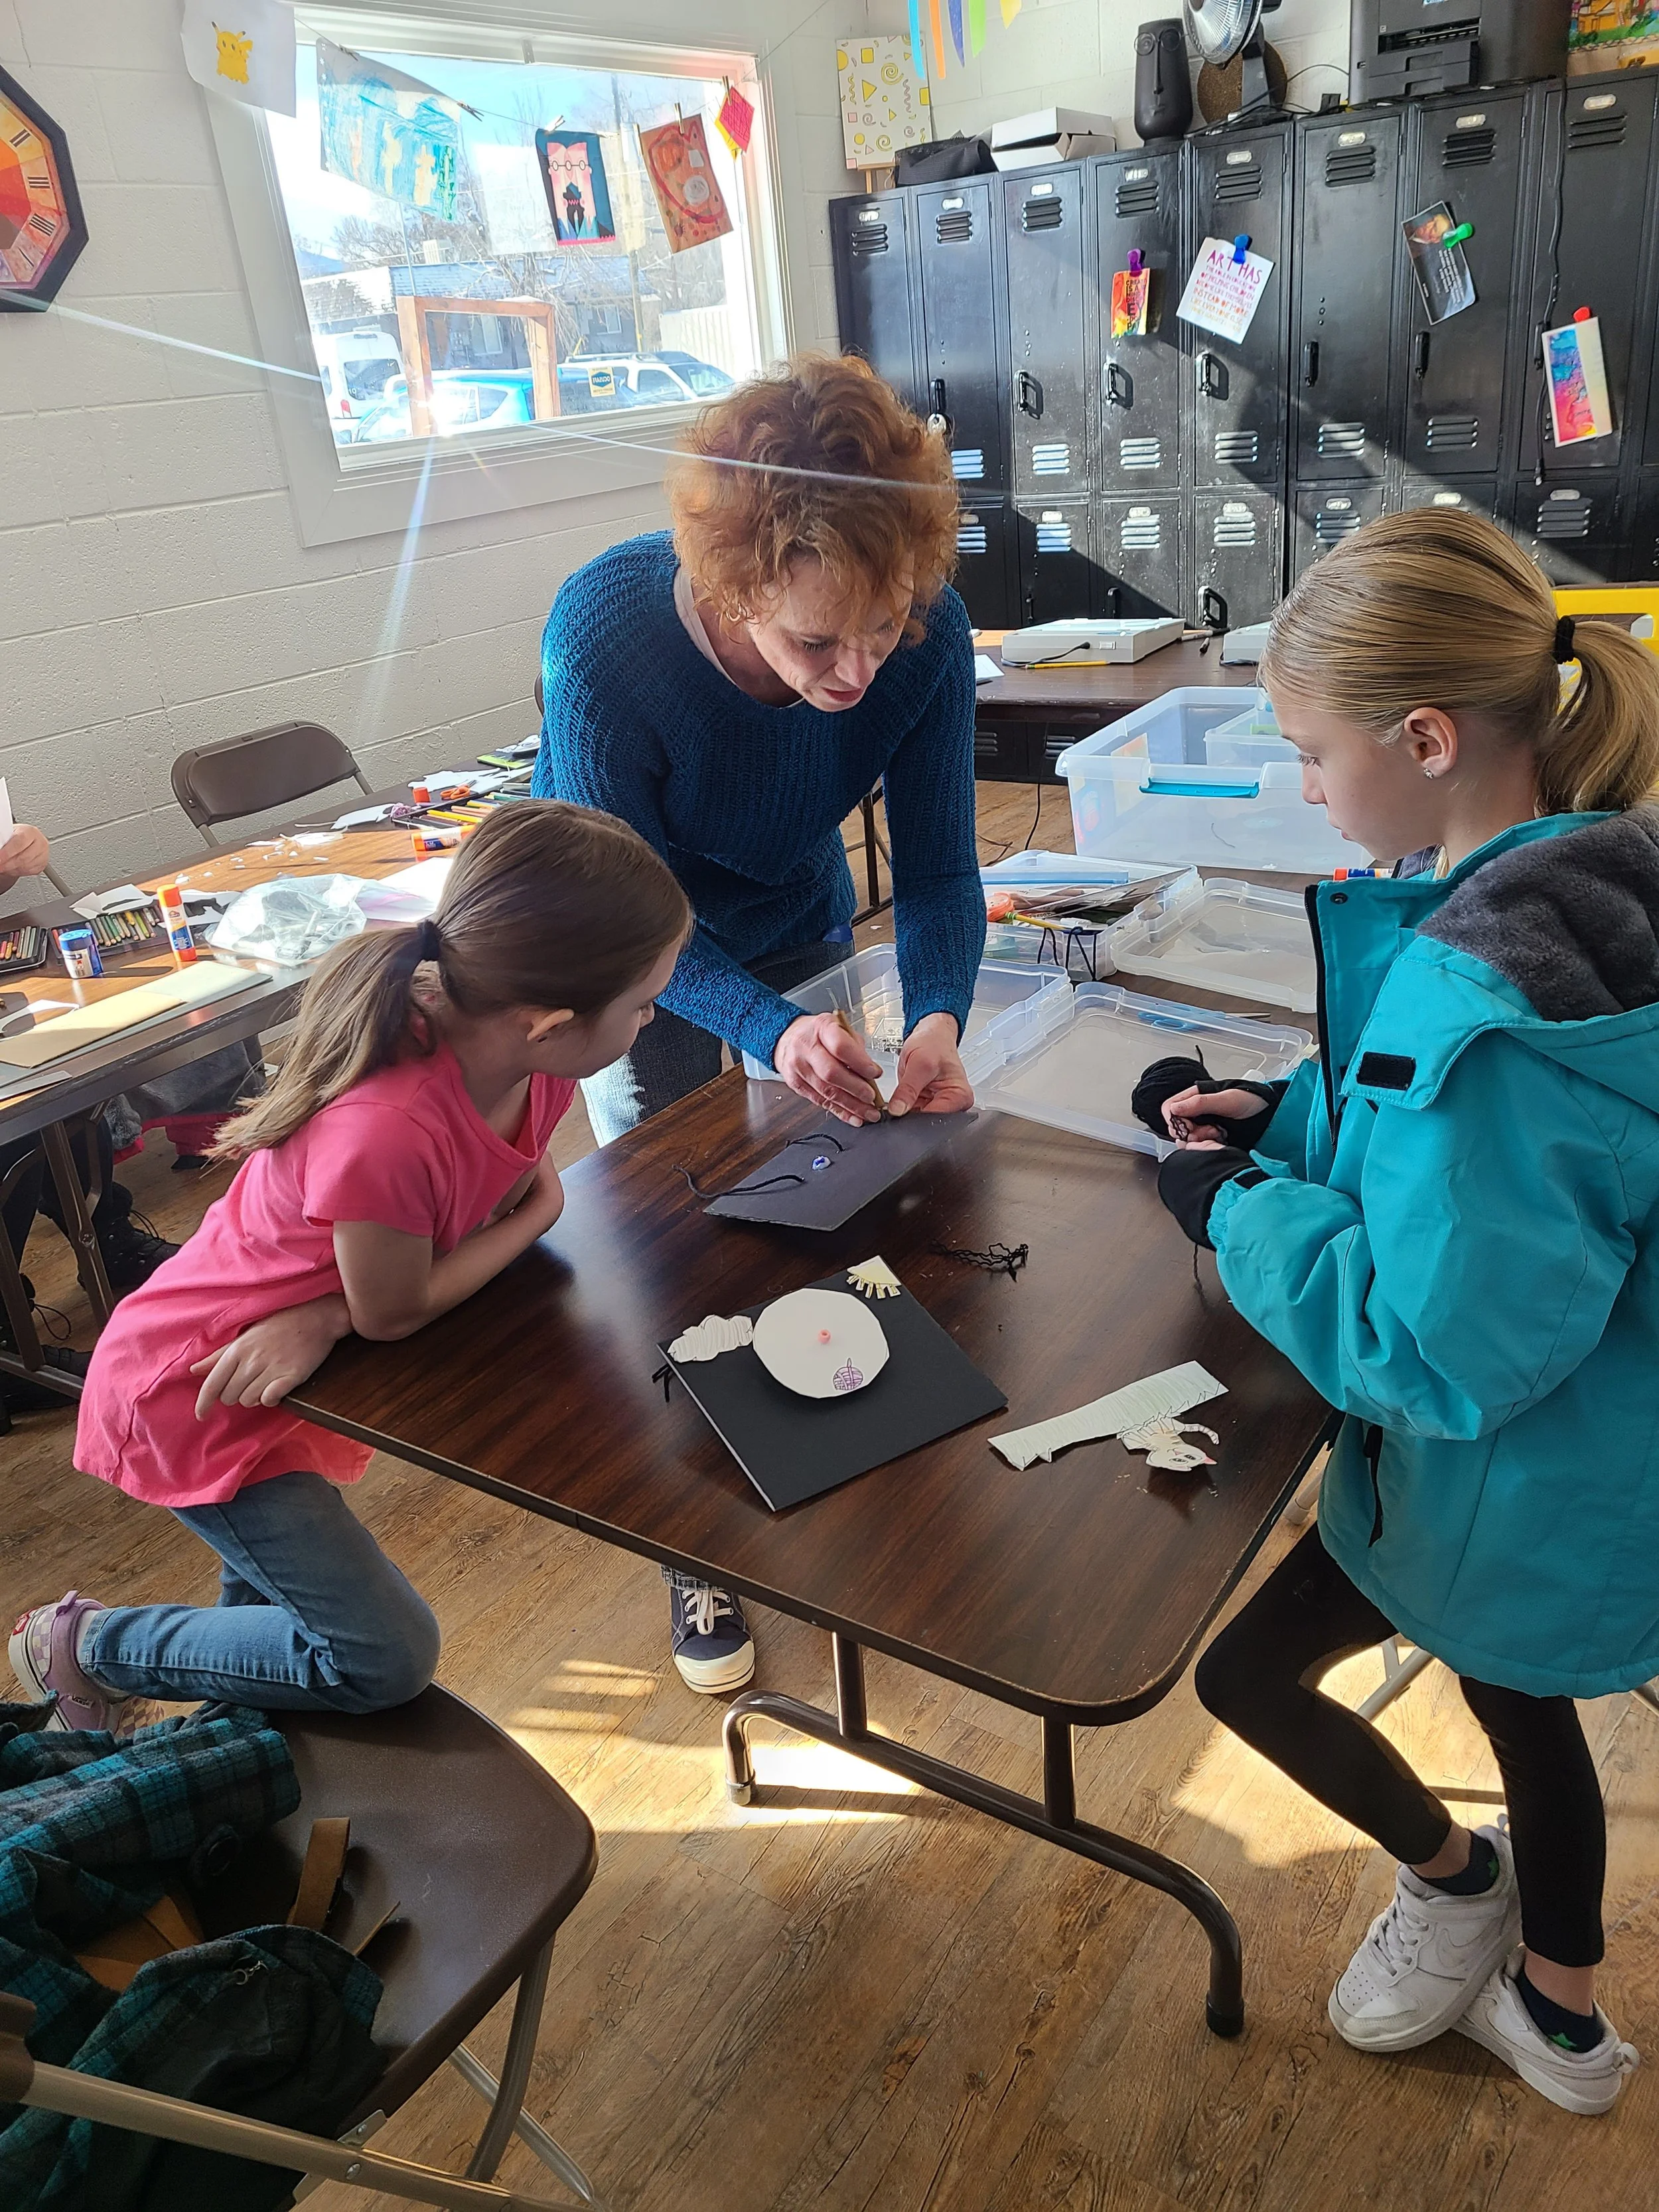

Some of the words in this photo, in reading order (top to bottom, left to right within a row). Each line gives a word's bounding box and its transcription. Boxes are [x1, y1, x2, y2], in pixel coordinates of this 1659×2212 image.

[1206, 250, 1234, 271] ART
[1238, 263, 1263, 285] HAS
[1193, 286, 1219, 305] INSTEAD
[1220, 299, 1230, 309] OF
[1230, 303, 1248, 318] MORE
